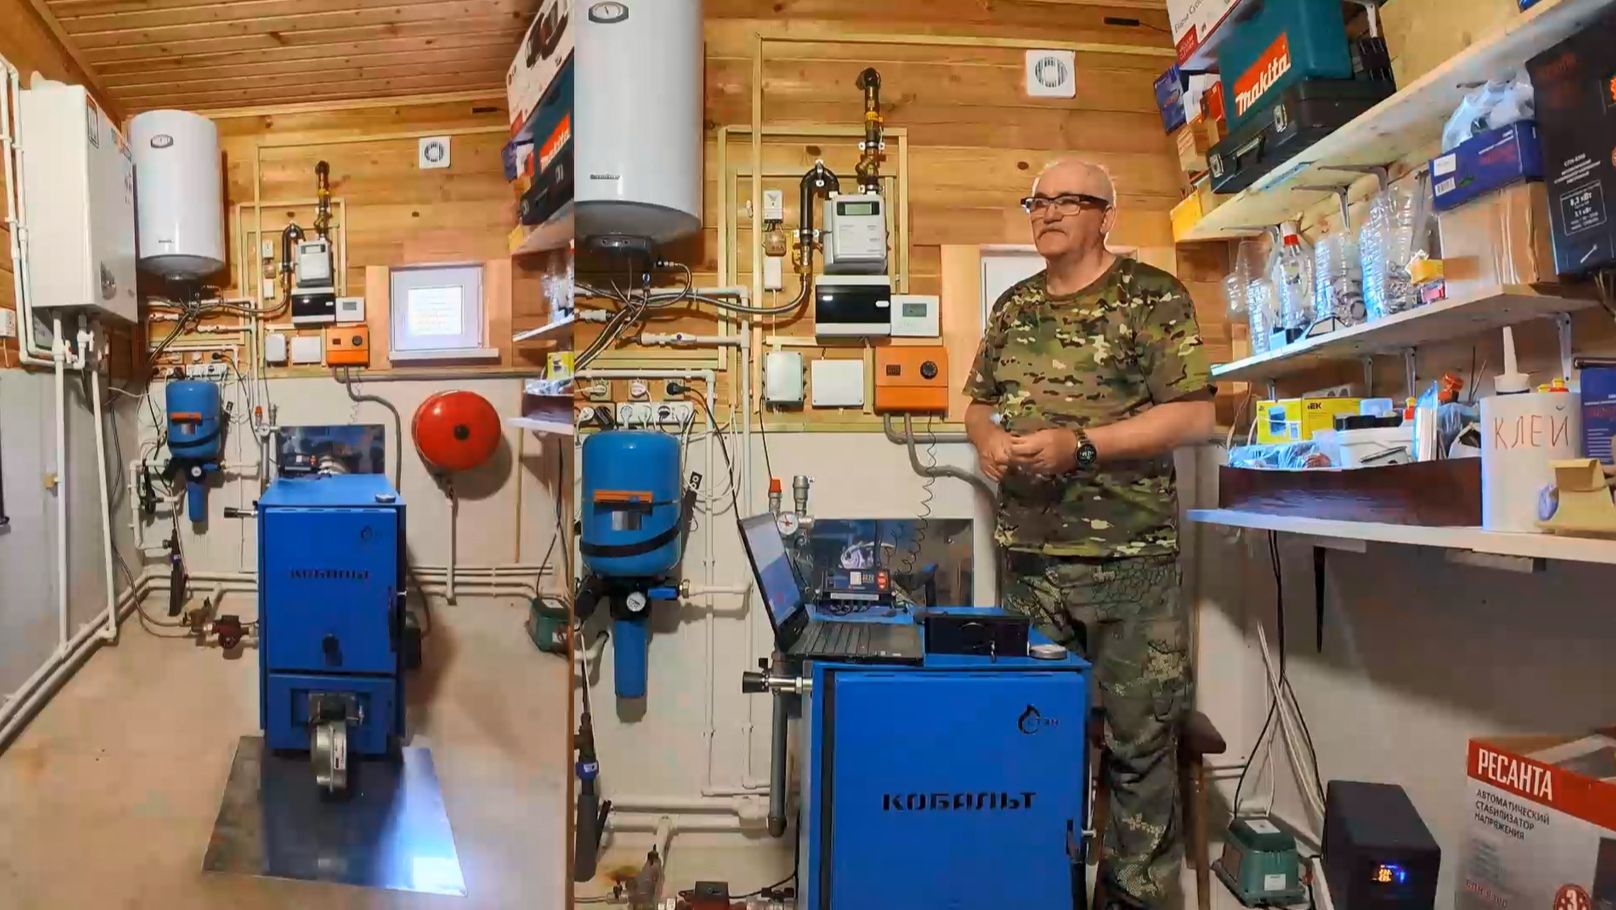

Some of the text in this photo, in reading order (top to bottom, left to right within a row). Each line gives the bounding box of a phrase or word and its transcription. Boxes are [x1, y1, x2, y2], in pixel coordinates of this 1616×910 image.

[1235, 52, 1291, 117] makita
[1494, 405, 1569, 449] КЛЕЙ
[1478, 748, 1553, 802] РЕСАНТА
[882, 792, 1037, 811] КОБАЛЬТ
[1475, 801, 1535, 831] СТАБИЛИЗАТОР
[1476, 789, 1550, 826] АВТОМАТИЧЕСКИЙ
[1474, 813, 1525, 841] НАПРЯЖЕНИЯ
